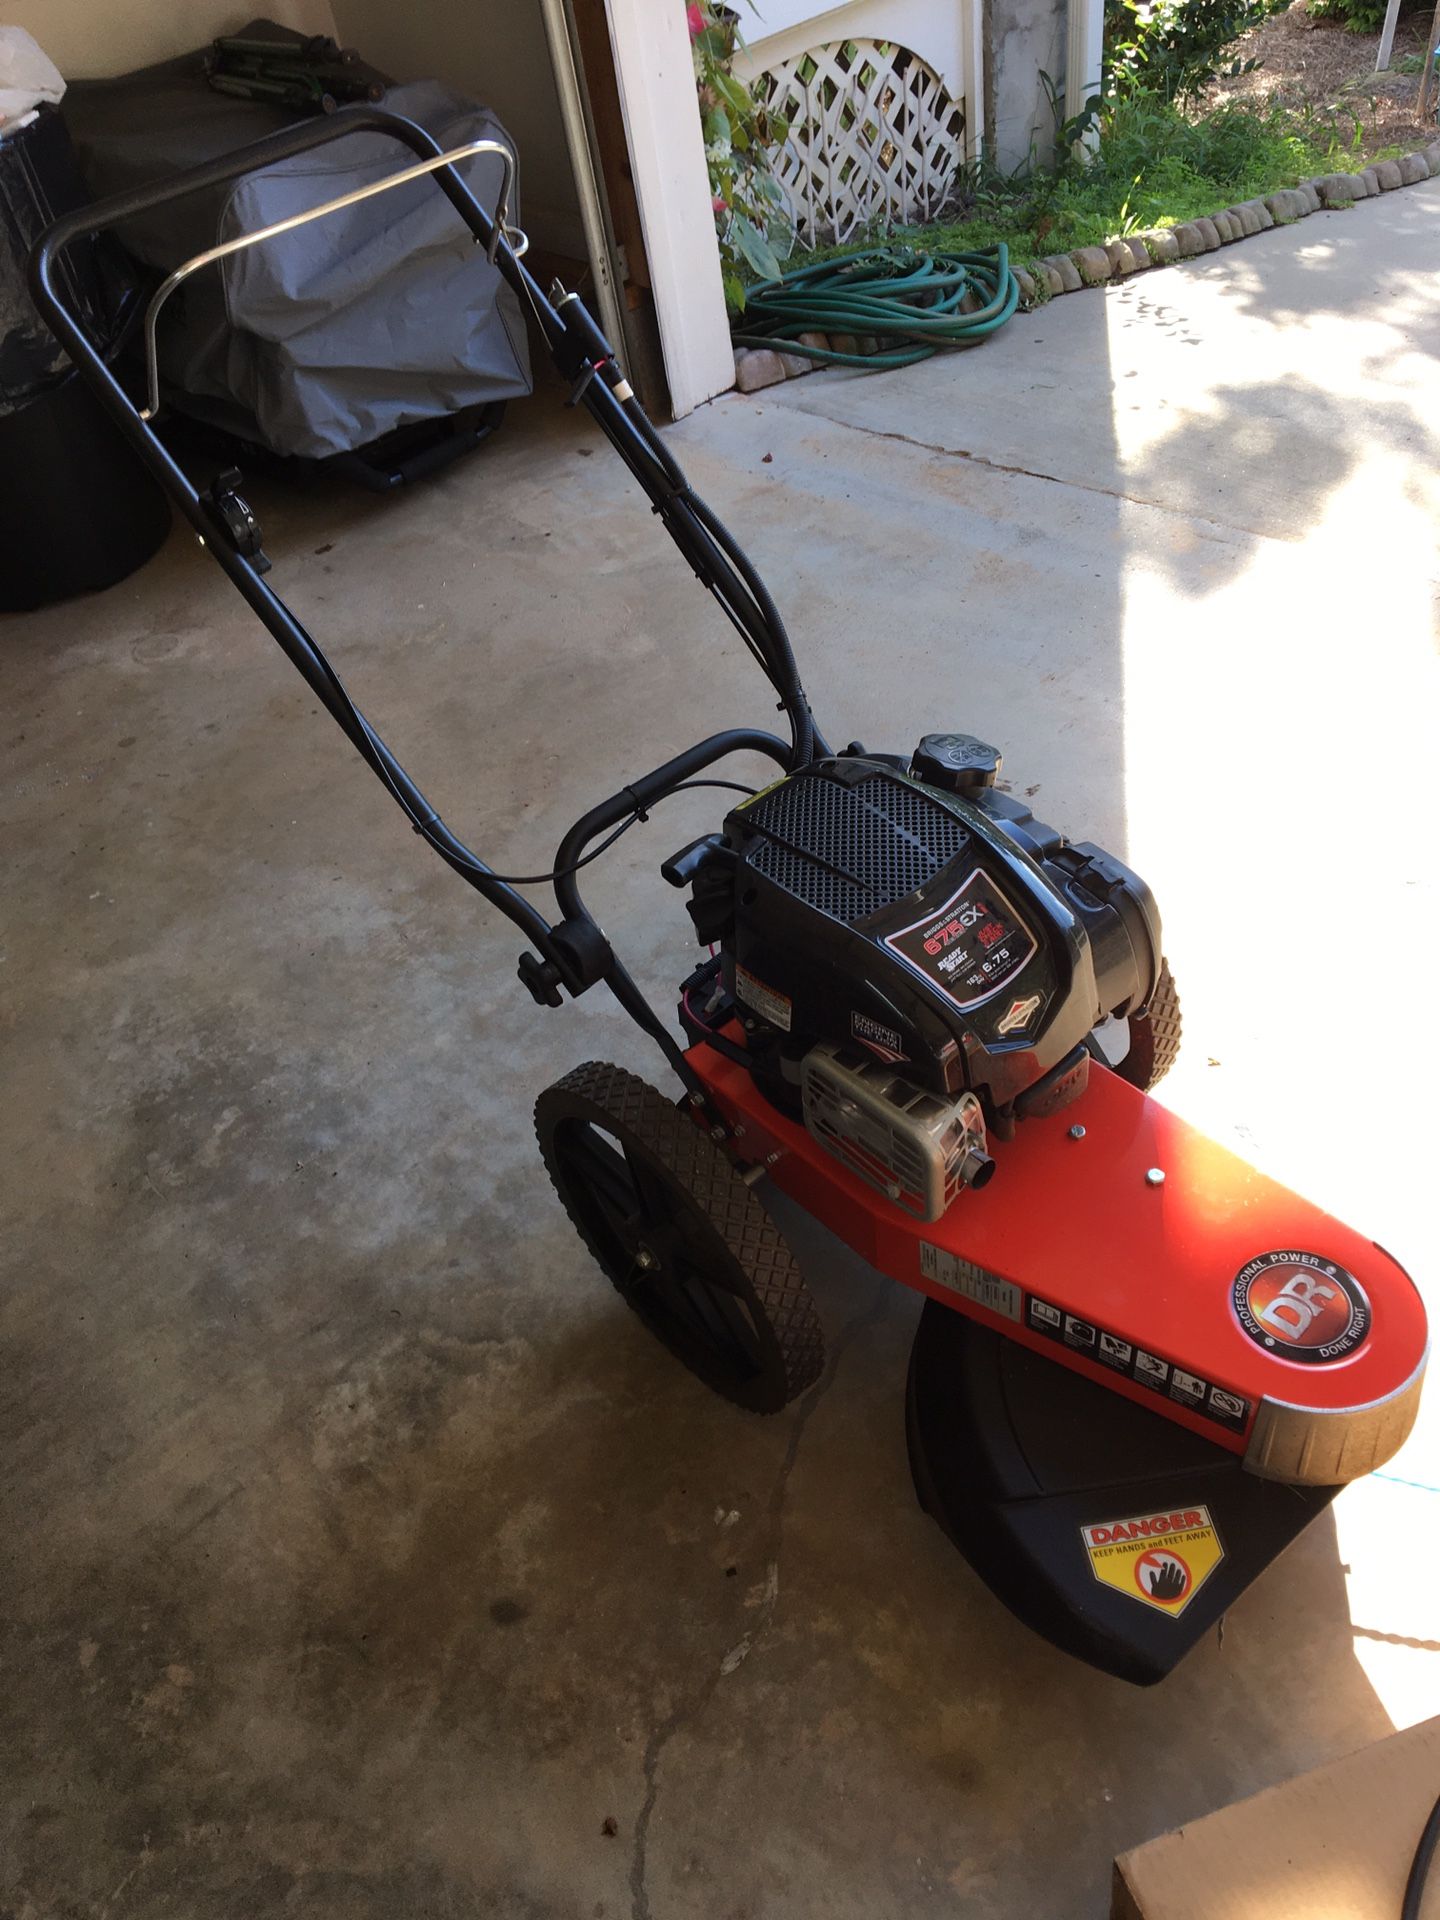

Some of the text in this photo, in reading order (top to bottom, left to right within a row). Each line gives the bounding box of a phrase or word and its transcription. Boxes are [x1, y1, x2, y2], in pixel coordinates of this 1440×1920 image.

[937, 946, 961, 971] READY
[945, 950, 969, 972] START
[982, 947, 1010, 972] 6.75
[1236, 1252, 1320, 1335] PROFESSIONAL POWER
[1260, 1273, 1337, 1340] DR
[1319, 1306, 1366, 1358] DONE RIGHT
[1090, 1511, 1204, 1545] DANGER
[1093, 1529, 1212, 1559] KEEP HANDS and FEET AWAY
